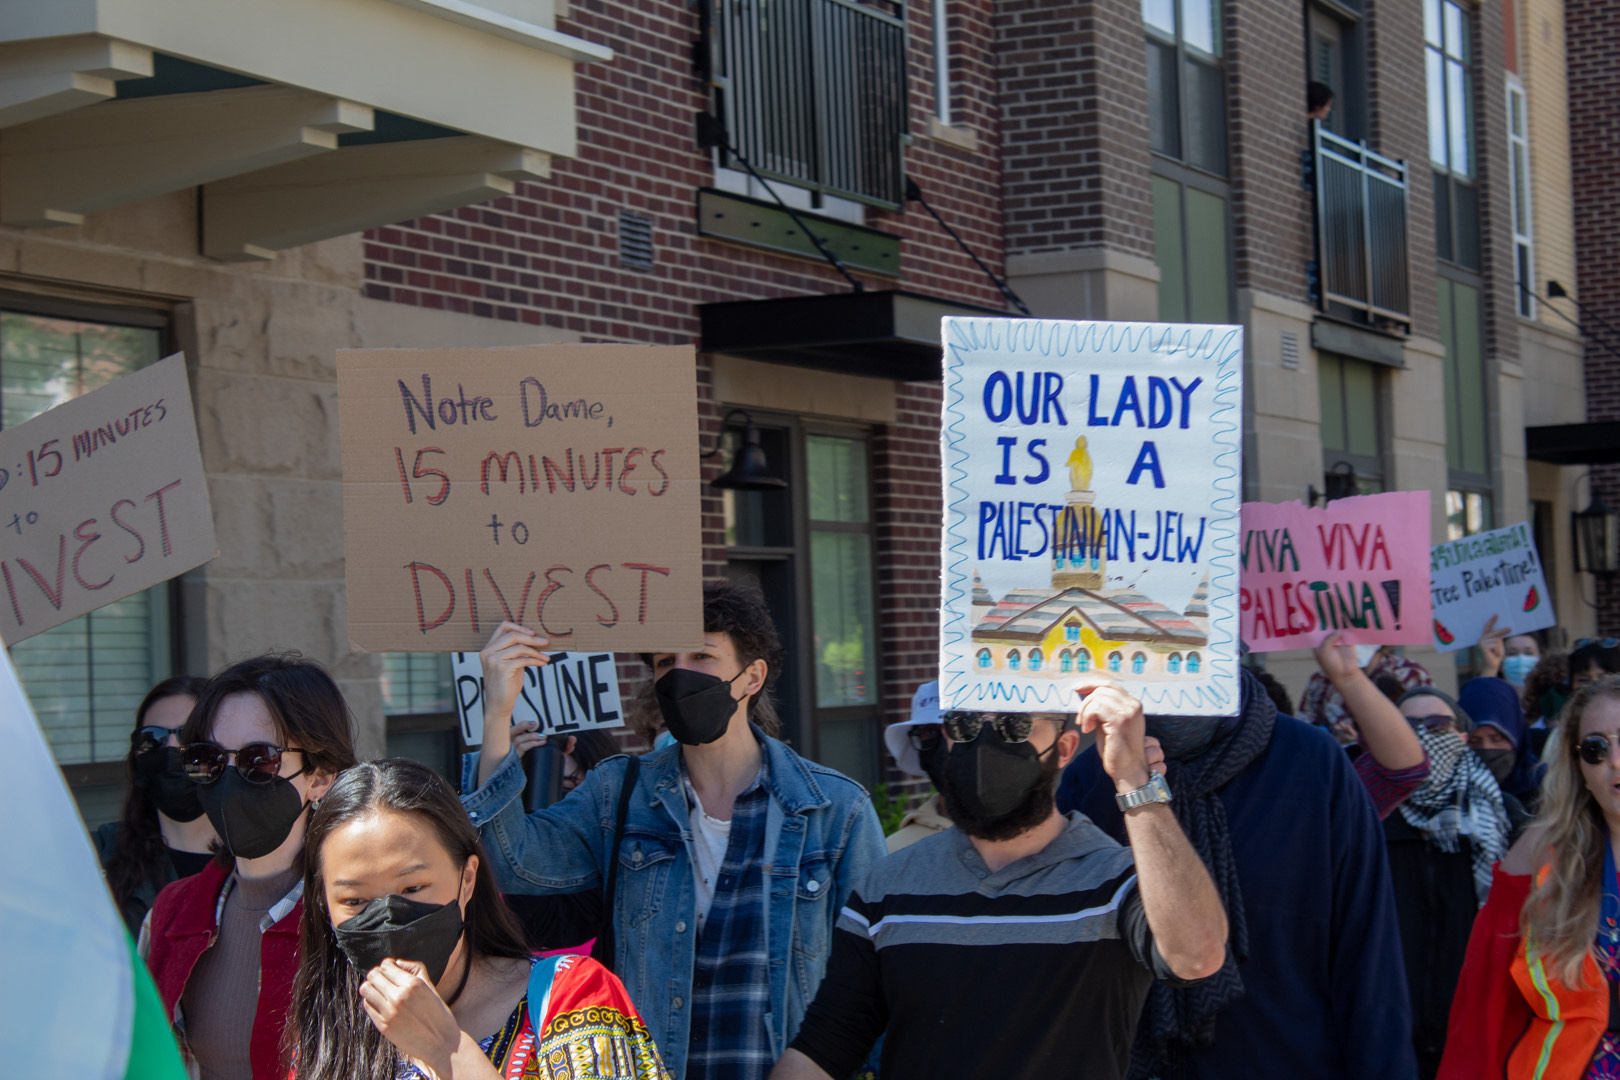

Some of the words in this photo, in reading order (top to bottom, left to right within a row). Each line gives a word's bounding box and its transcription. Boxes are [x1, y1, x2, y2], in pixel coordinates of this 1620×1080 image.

[72, 398, 167, 462] MINUTES
[397, 373, 498, 435] Notre
[519, 376, 613, 428] Dame,
[983, 370, 1068, 426] OUR
[1087, 373, 1203, 430] LADY
[394, 446, 451, 506] 15
[480, 447, 669, 496] MINUTES
[994, 436, 1051, 486] IS
[1126, 440, 1166, 489] A
[5, 511, 39, 536] to
[486, 514, 529, 545] to
[977, 500, 1207, 564] PALESTINIAN-JEW
[1241, 527, 1300, 573] VIVA
[1317, 522, 1392, 571] VIVA
[404, 561, 670, 638] DIVEST
[1462, 550, 1538, 598] Palestine!
